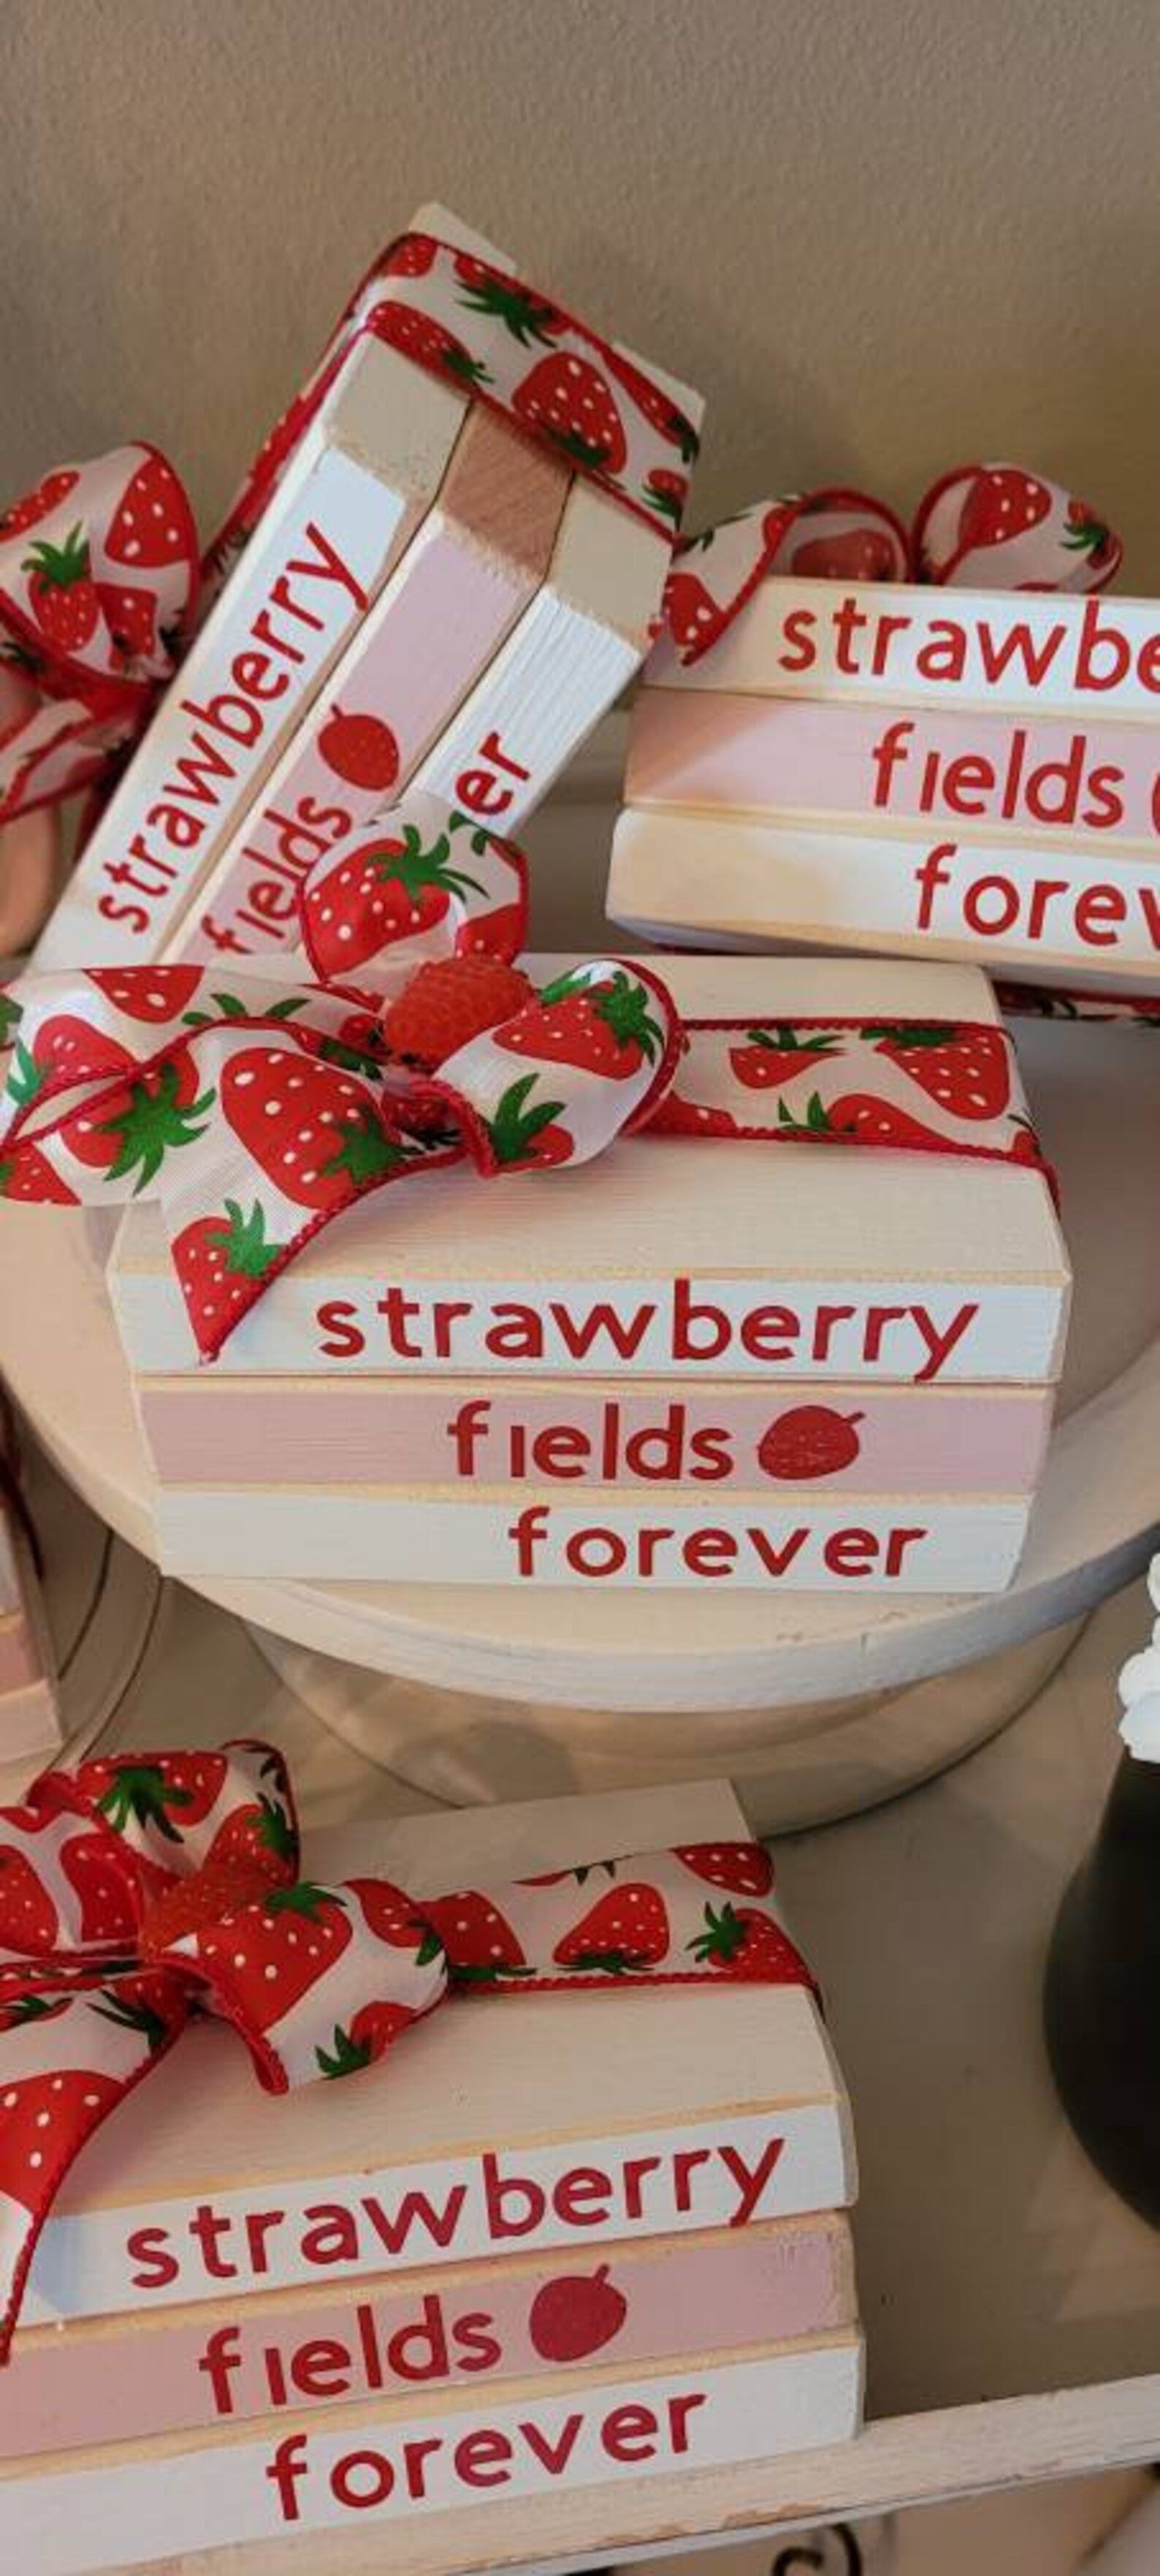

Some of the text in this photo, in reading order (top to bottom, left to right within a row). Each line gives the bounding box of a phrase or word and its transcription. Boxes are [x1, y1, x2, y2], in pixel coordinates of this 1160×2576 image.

[98, 521, 370, 933] strawberry
[872, 722, 1124, 828] fields
[316, 1276, 979, 1384] strawberry
[447, 1399, 735, 1482] fields
[509, 1504, 926, 1578] forever
[126, 2138, 784, 2289] strawberry
[198, 2293, 503, 2415] fields
[266, 2393, 706, 2521] forever
